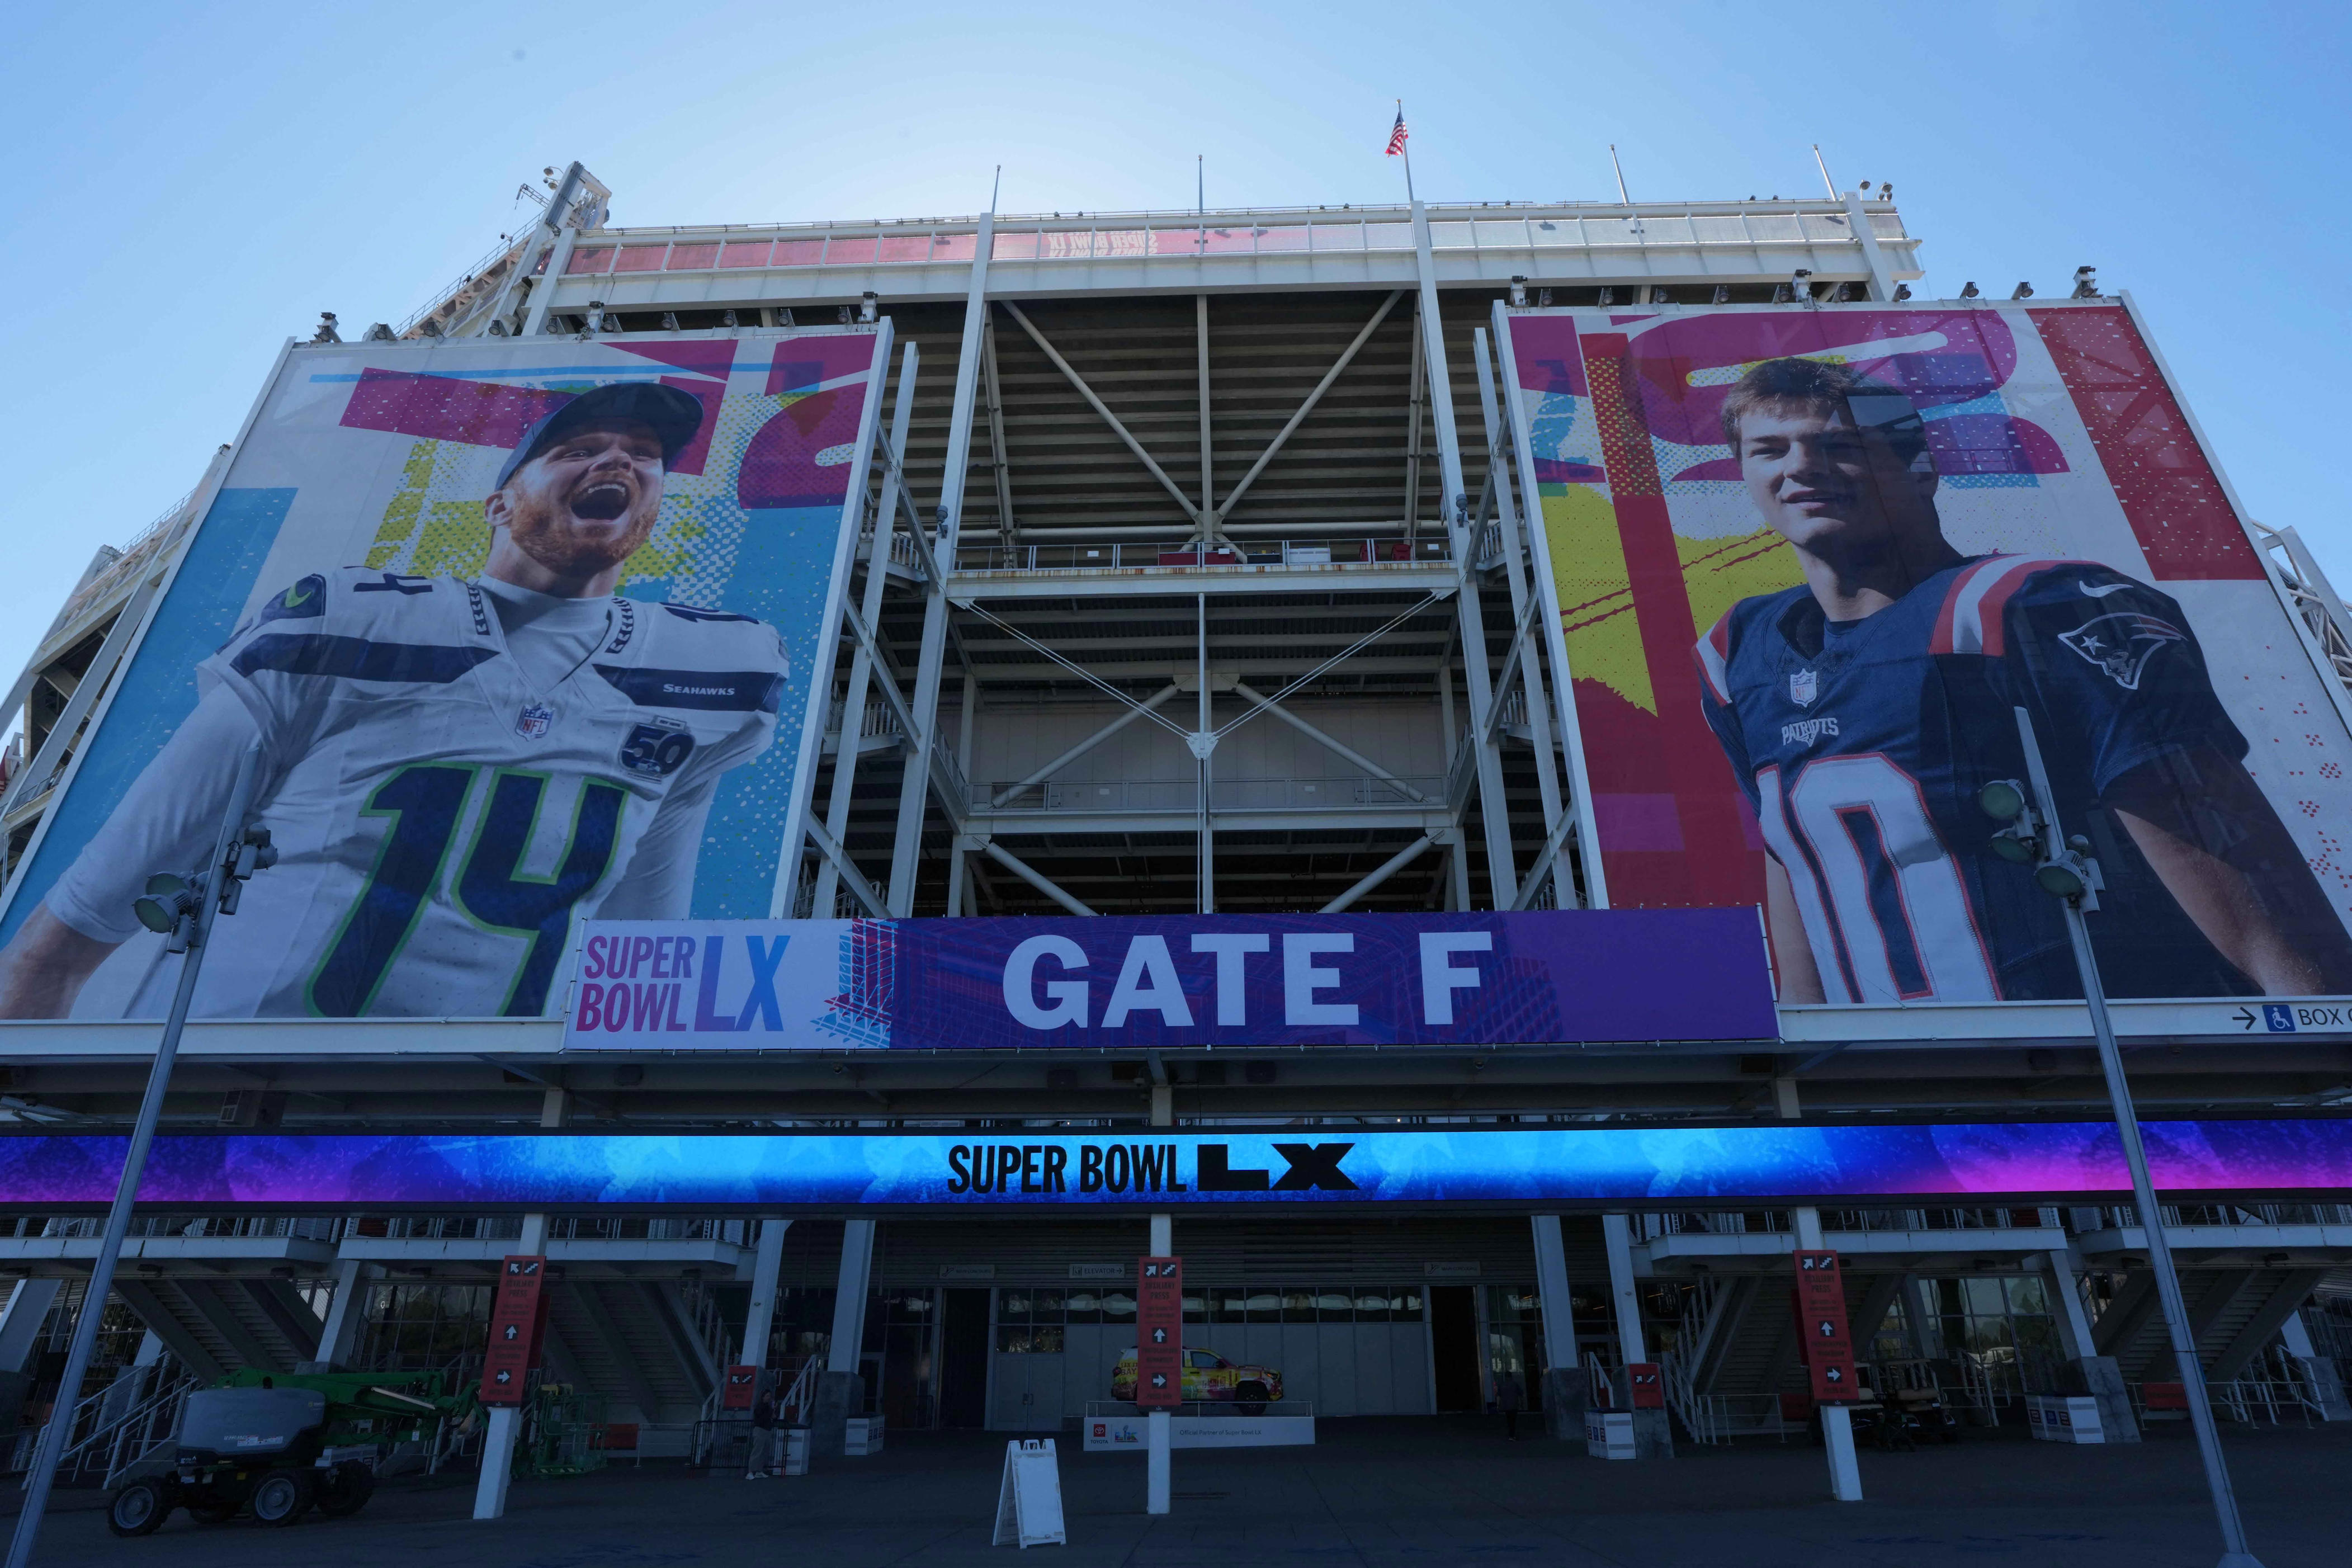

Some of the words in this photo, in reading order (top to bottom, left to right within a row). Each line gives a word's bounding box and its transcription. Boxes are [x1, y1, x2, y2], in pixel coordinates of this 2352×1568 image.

[663, 683, 735, 696] SEAHAWKS
[523, 719, 543, 733] NFL
[621, 725, 695, 775] 50
[1782, 717, 1839, 746] PATRIOTS
[304, 760, 629, 1017] 14
[1756, 752, 2004, 1003] 10
[584, 936, 696, 979] SUPER
[1003, 933, 1359, 1030] GATE
[1419, 931, 1493, 1024] F
[575, 983, 687, 1032] BOWL
[694, 935, 791, 1032] LX
[2298, 1009, 2344, 1025] BOX
[948, 1145, 1067, 1194] SUPER
[1080, 1144, 1187, 1193] BOWL
[1197, 1142, 1360, 1192] LX
